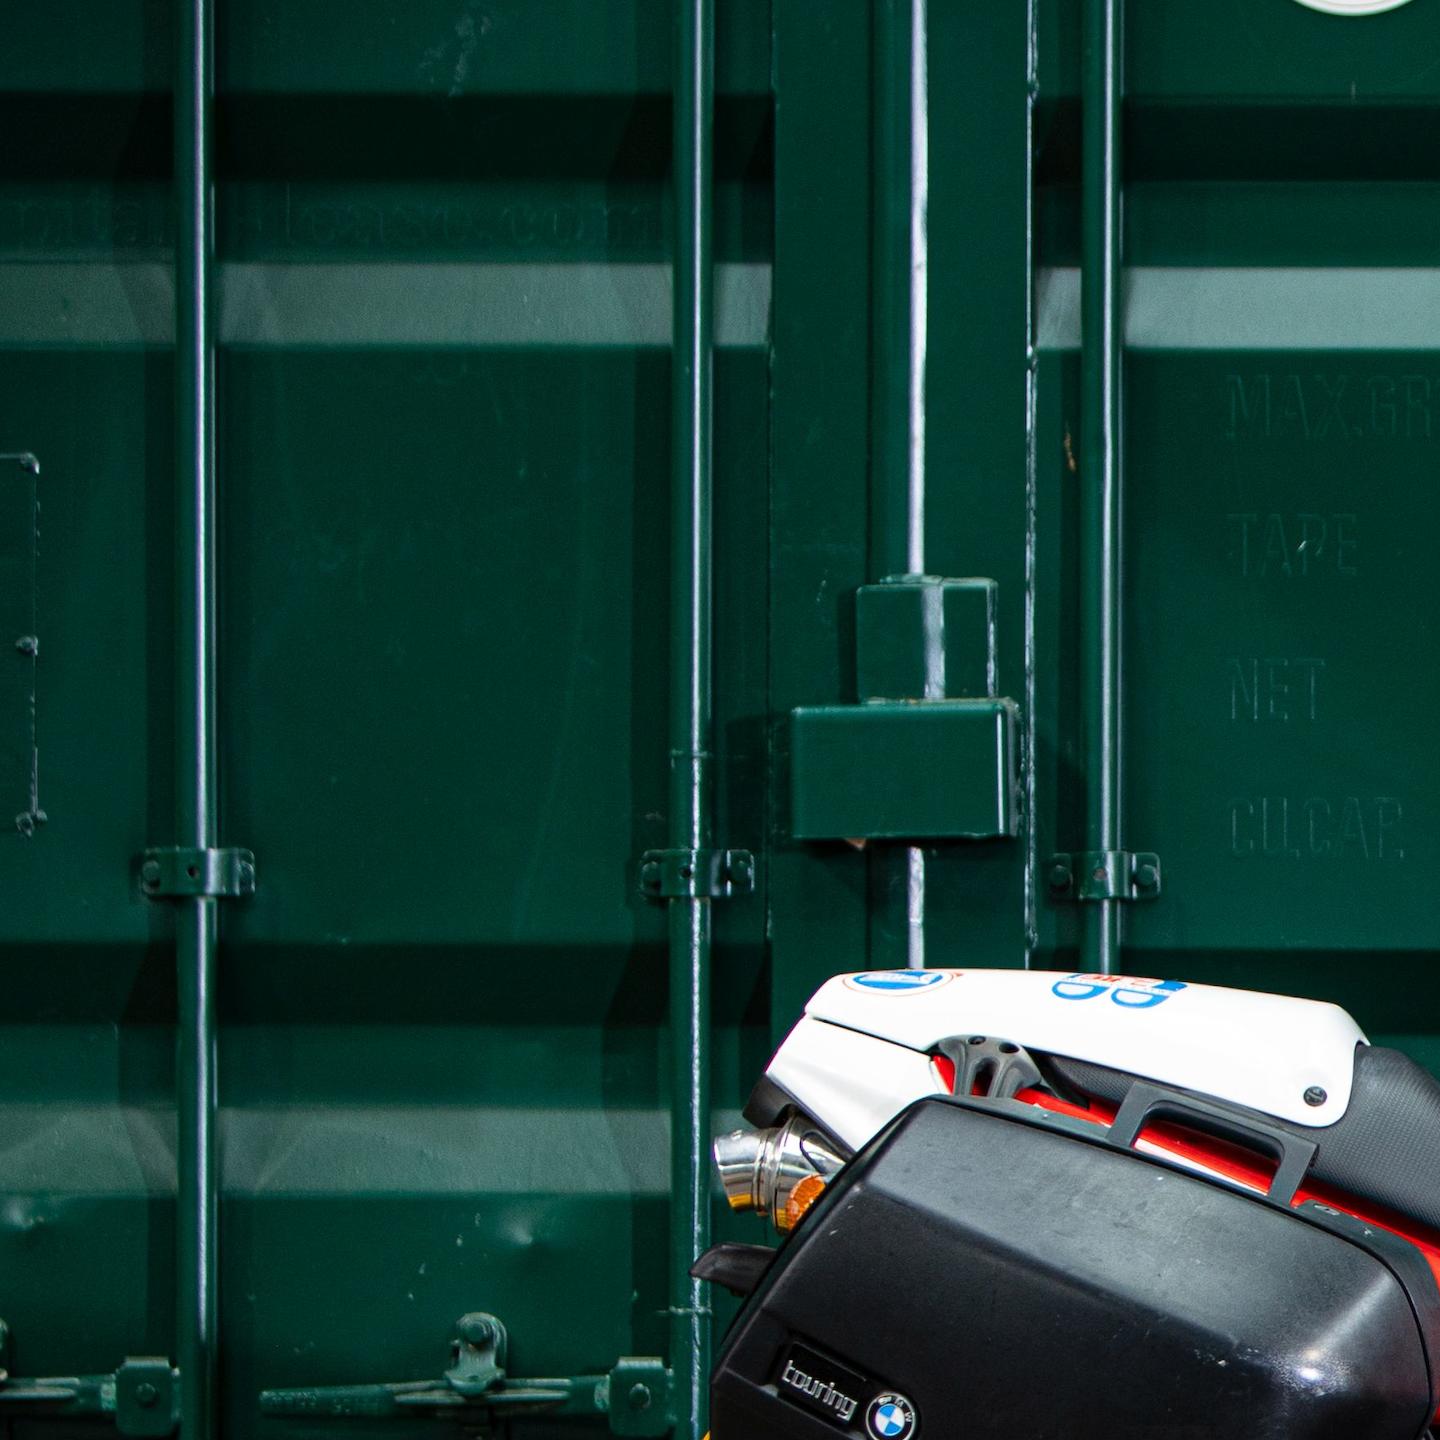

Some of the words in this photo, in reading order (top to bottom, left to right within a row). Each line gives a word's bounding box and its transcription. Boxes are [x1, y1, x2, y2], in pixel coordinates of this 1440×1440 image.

[1226, 657, 1327, 722] NET
[780, 1358, 859, 1422] touring
[877, 1395, 914, 1424] BMW
